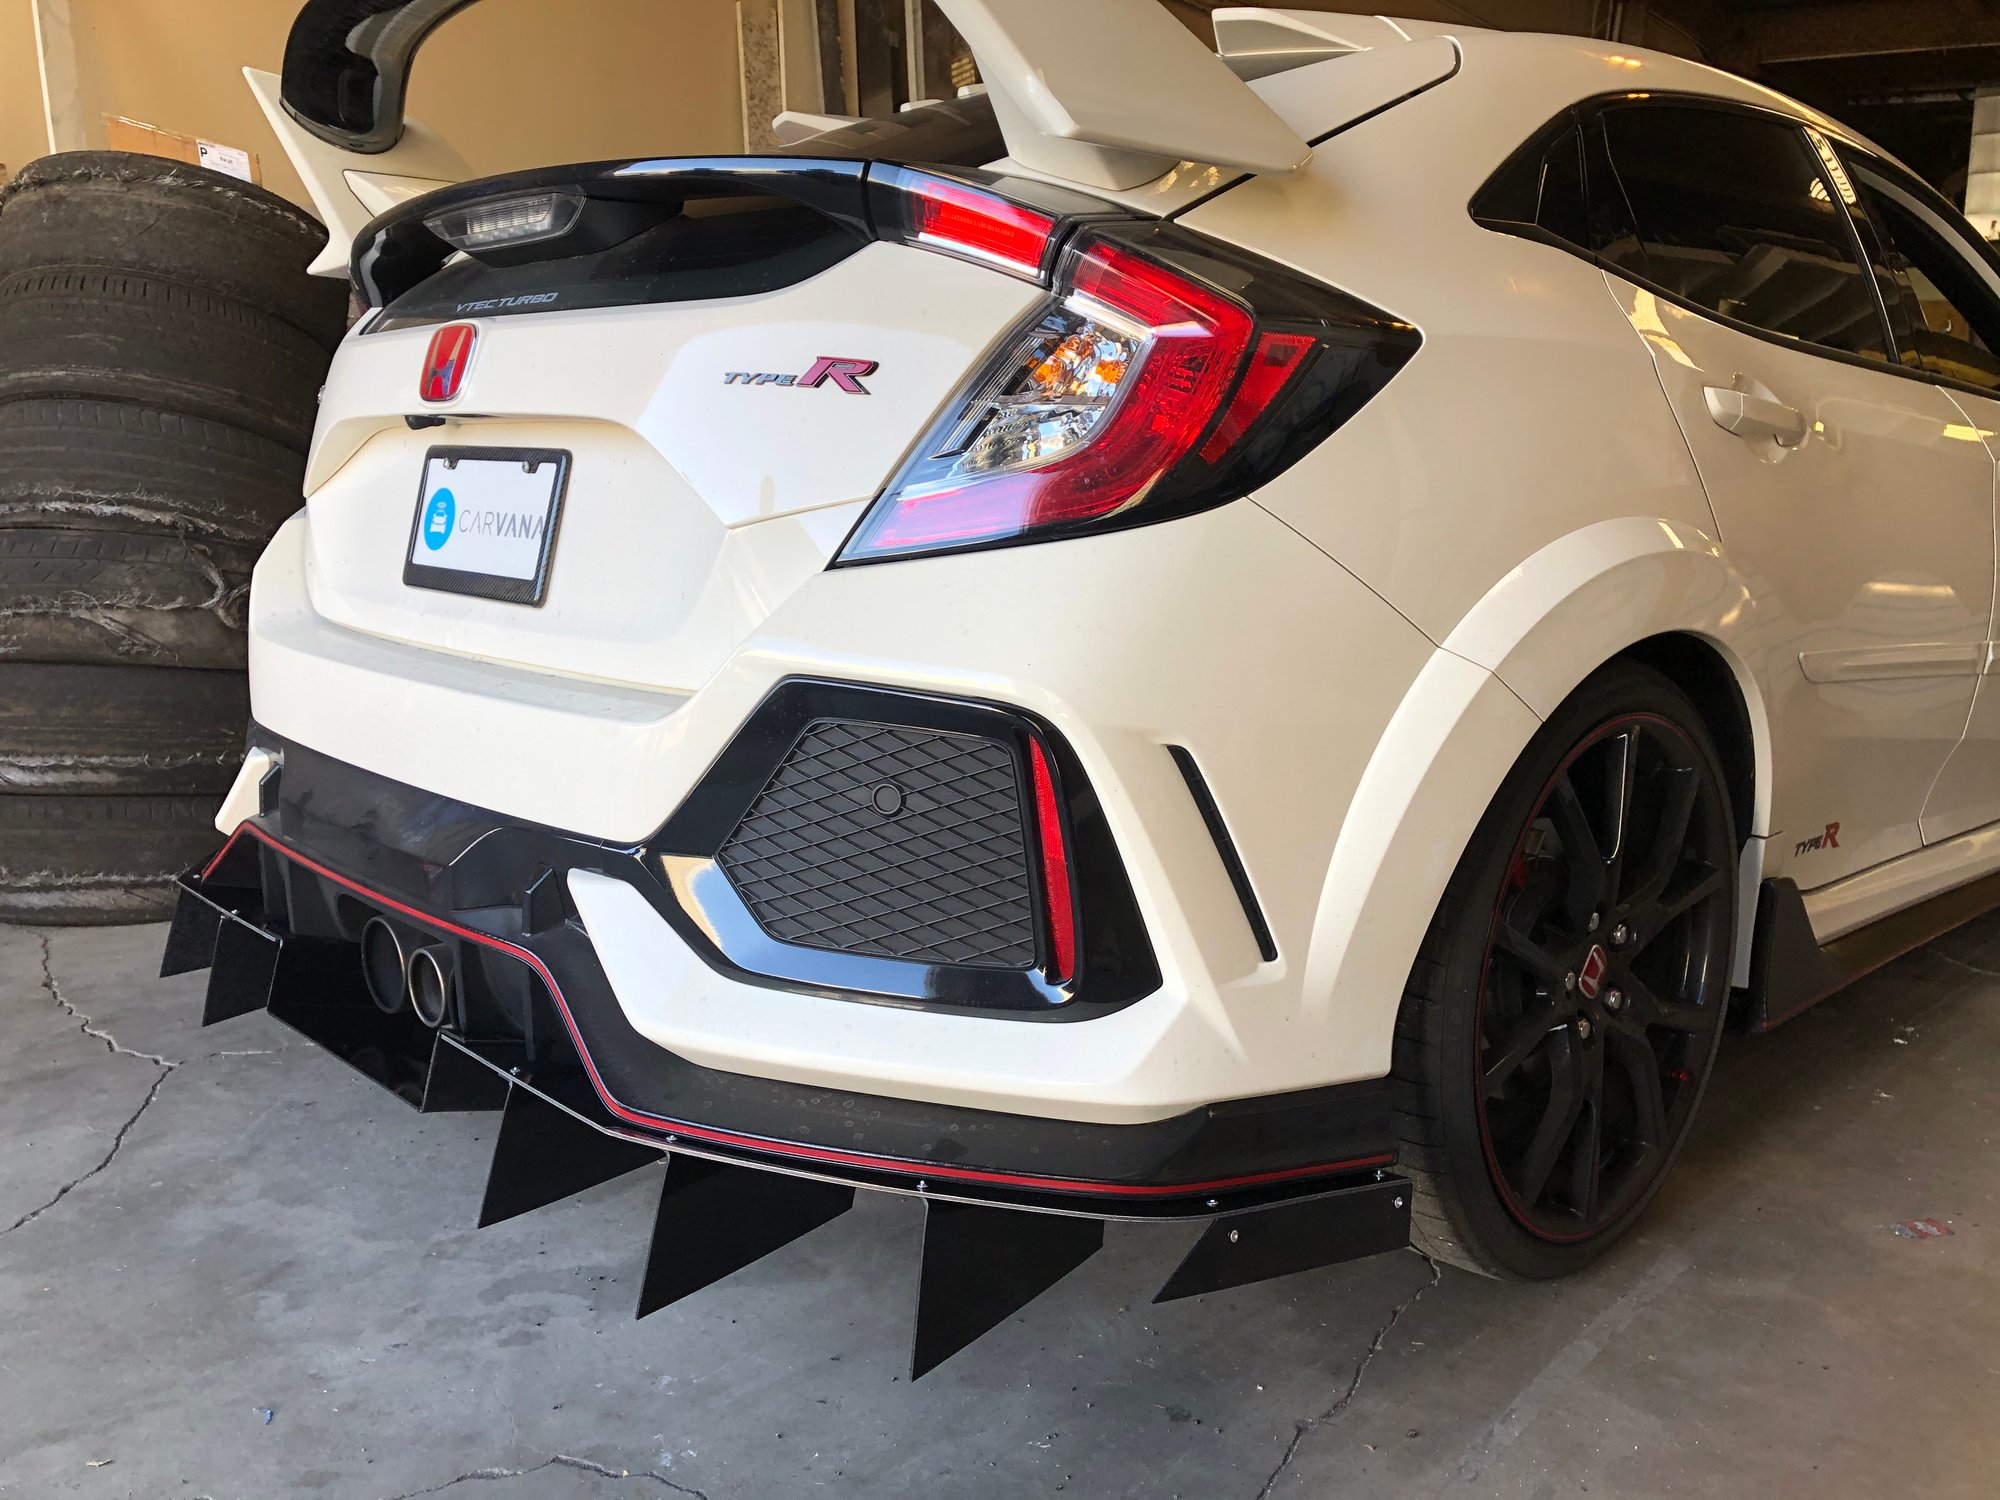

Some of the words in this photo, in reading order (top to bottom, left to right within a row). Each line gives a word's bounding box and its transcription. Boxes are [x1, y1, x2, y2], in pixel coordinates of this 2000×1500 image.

[200, 147, 208, 157] P
[456, 300, 500, 313] VTEC
[498, 292, 560, 307] TURBO
[724, 371, 799, 387] TYPE
[796, 356, 880, 395] R
[458, 509, 545, 539] CARVANA
[1794, 835, 1823, 857] TYPE
[1821, 821, 1840, 849] R
